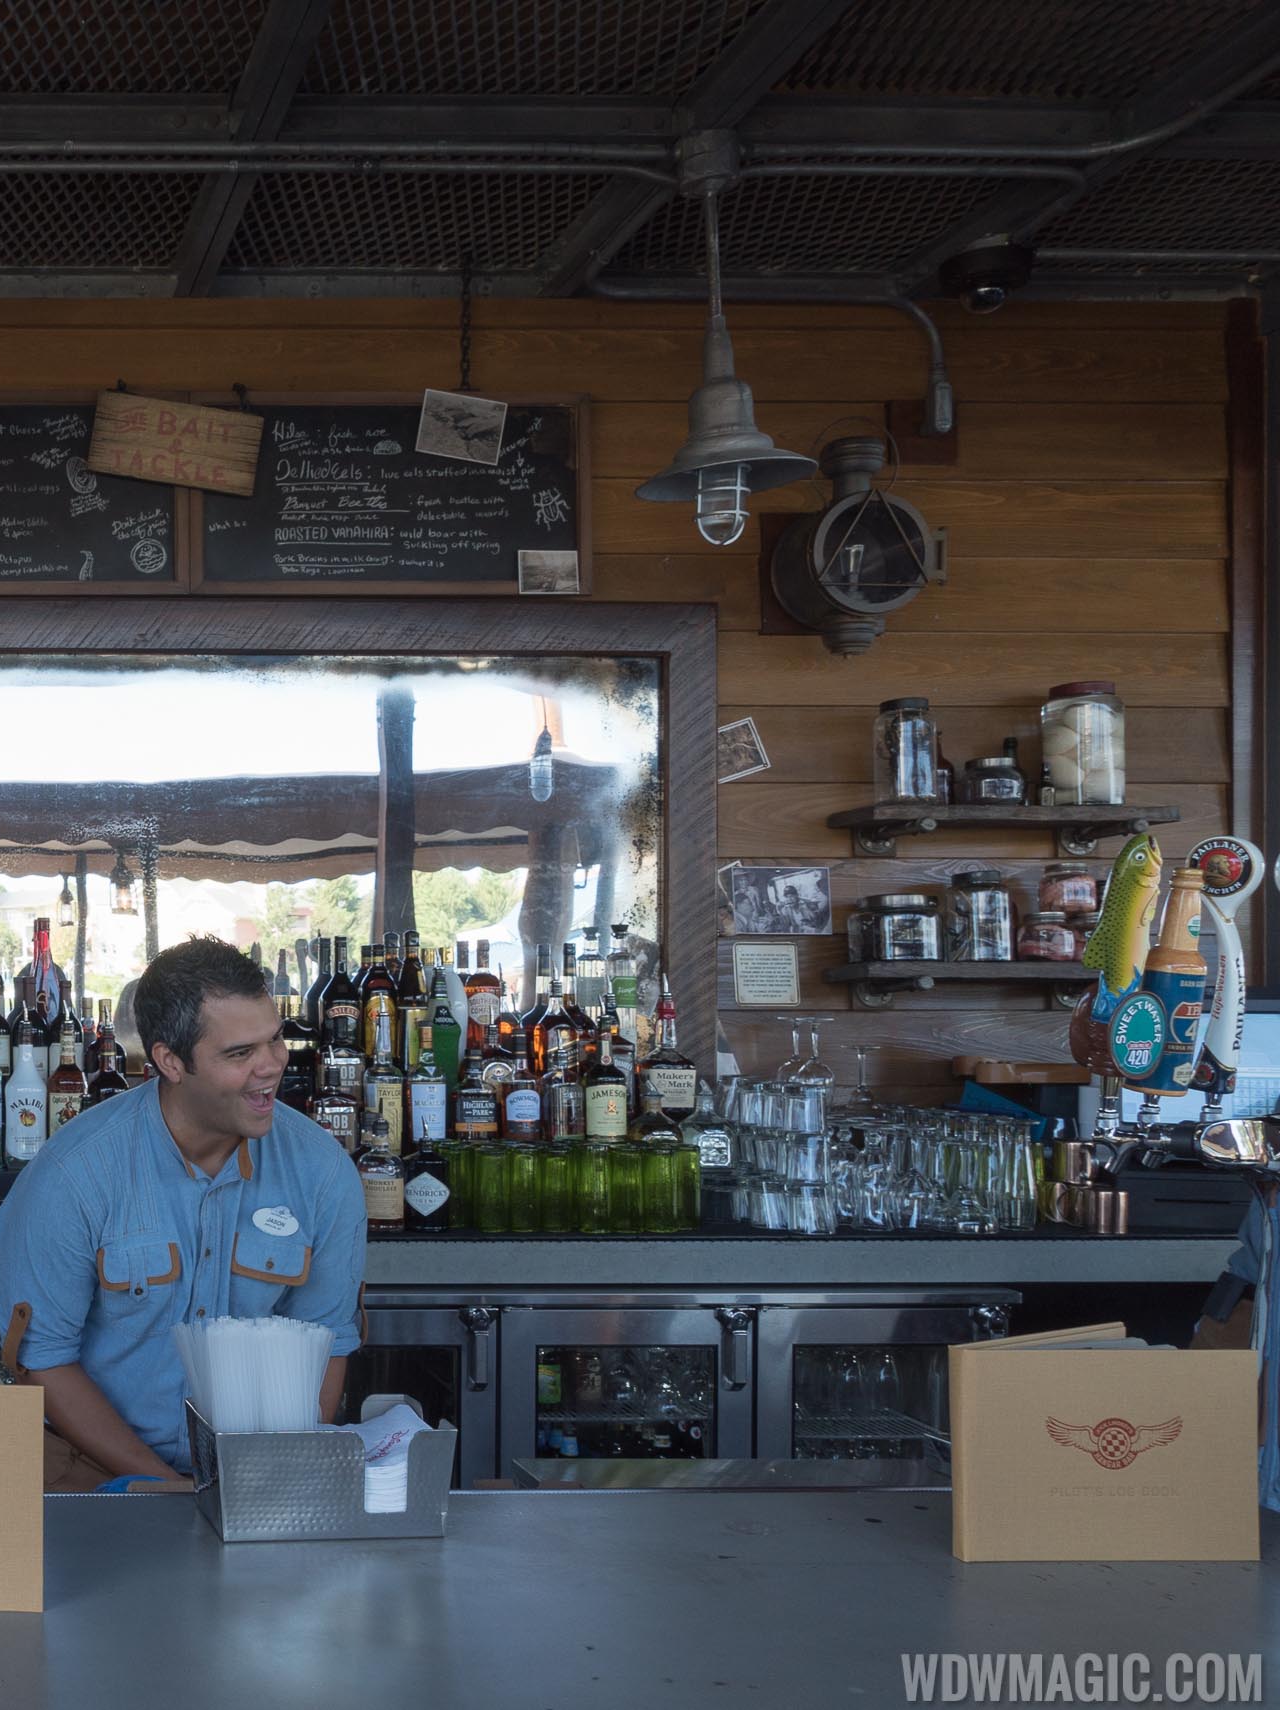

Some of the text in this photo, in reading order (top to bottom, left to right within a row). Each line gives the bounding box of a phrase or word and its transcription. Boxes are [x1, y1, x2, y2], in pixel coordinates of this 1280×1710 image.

[158, 409, 235, 444] BAIT
[169, 435, 183, 454] &
[110, 448, 226, 485] TACKLE
[274, 526, 328, 542] ROASTED
[0, 554, 33, 567] Octopus
[1191, 840, 1250, 864] PAULANER
[1115, 1000, 1162, 1045] SWEETWATER
[1127, 1049, 1150, 1066] 420
[656, 1071, 694, 1080] Maker's
[668, 1080, 693, 1088] Mark
